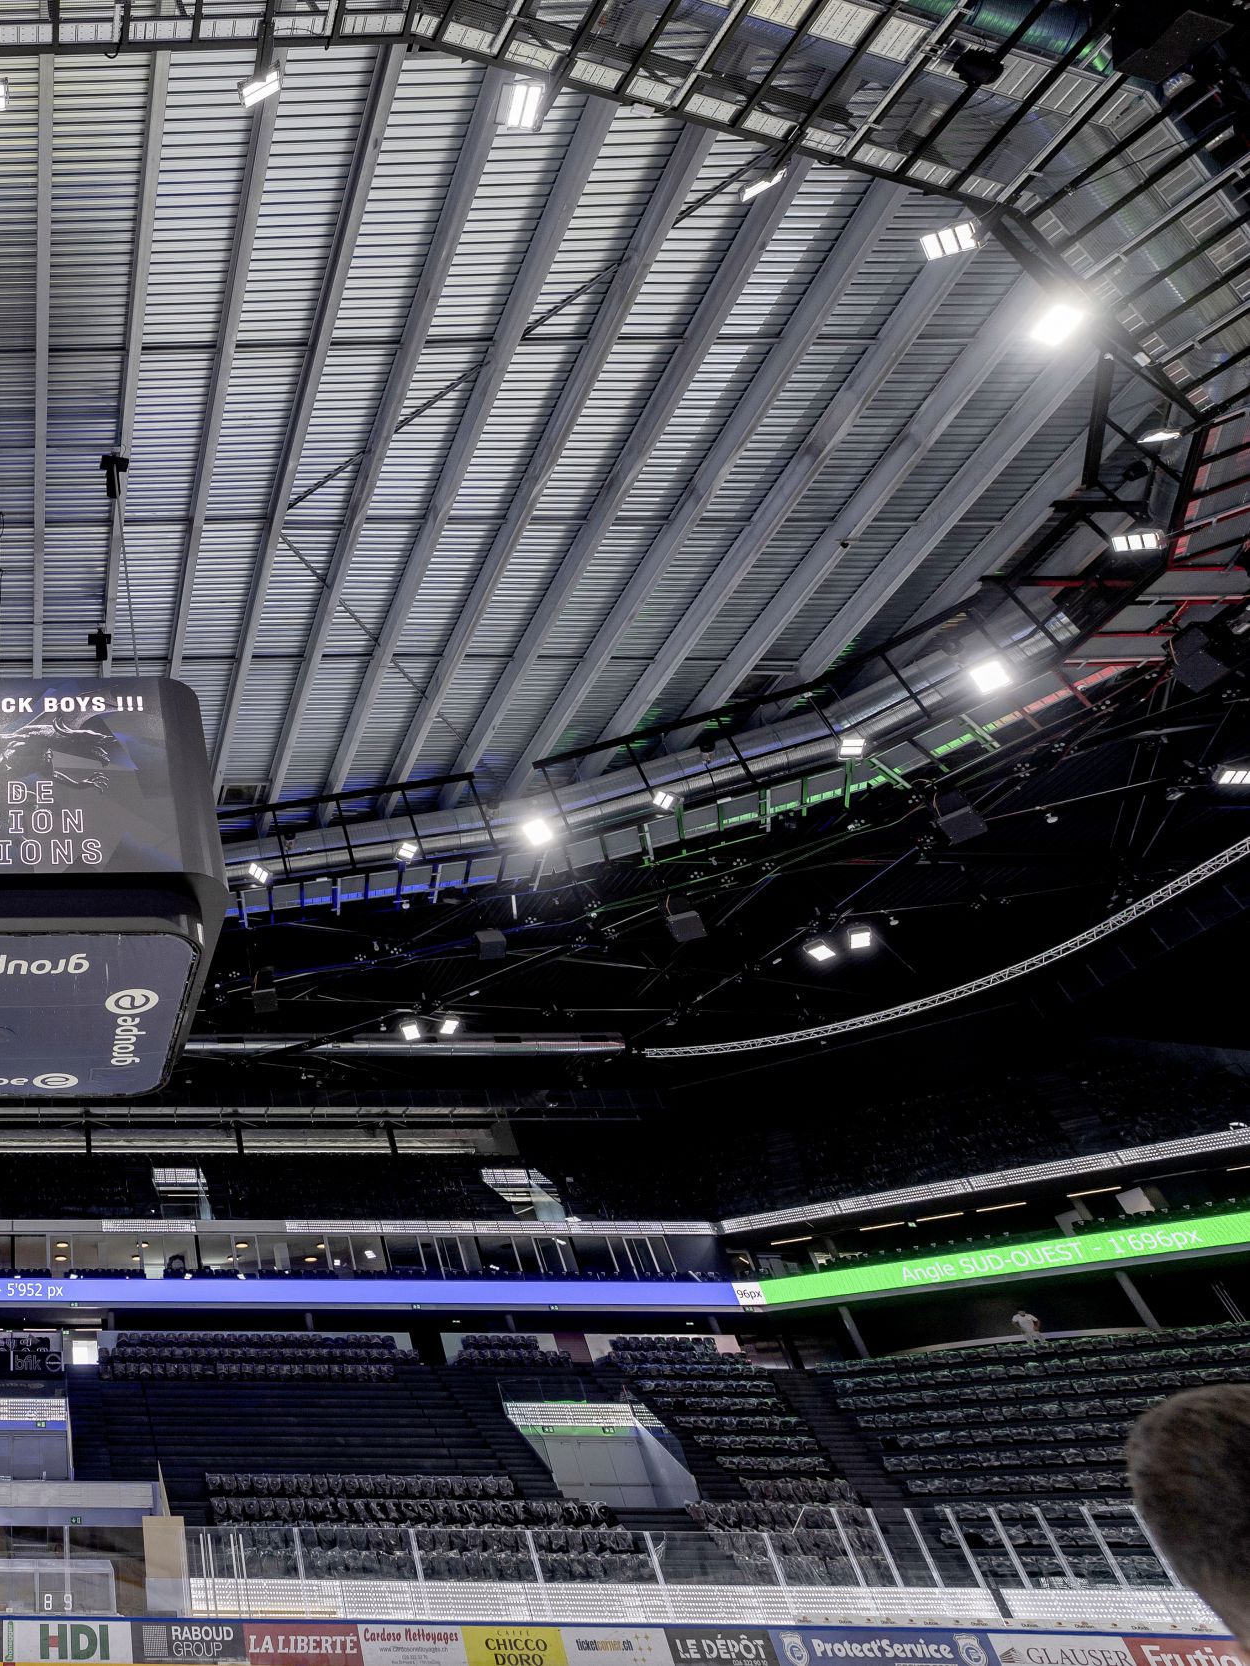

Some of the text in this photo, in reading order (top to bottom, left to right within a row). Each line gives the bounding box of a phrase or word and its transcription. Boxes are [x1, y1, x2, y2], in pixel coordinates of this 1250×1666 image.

[44, 696, 106, 713] BOYS
[116, 695, 144, 712] !!!
[111, 1016, 146, 1066] groupe
[901, 1260, 957, 1283] Angle
[959, 1241, 1083, 1274] SUD-OUEST
[1108, 1228, 1204, 1255] 1'696px
[6, 1282, 43, 1297] 5'952
[47, 1285, 64, 1299] px
[737, 1289, 762, 1300] 96px
[39, 1623, 110, 1660] HDI
[171, 1626, 234, 1641] RABOUD
[363, 1627, 459, 1645] Cardoso Nettoyages
[172, 1641, 223, 1657] GROUP
[248, 1633, 358, 1654] LA LIBERTÉ
[485, 1638, 548, 1652] CHICCO
[576, 1638, 633, 1652] ticketcorner.ch
[675, 1633, 767, 1659] LE DÉPÔT
[811, 1638, 955, 1659] Protect'Service
[494, 1653, 544, 1666] D'ORO
[1027, 1647, 1133, 1666] GLAUSER
